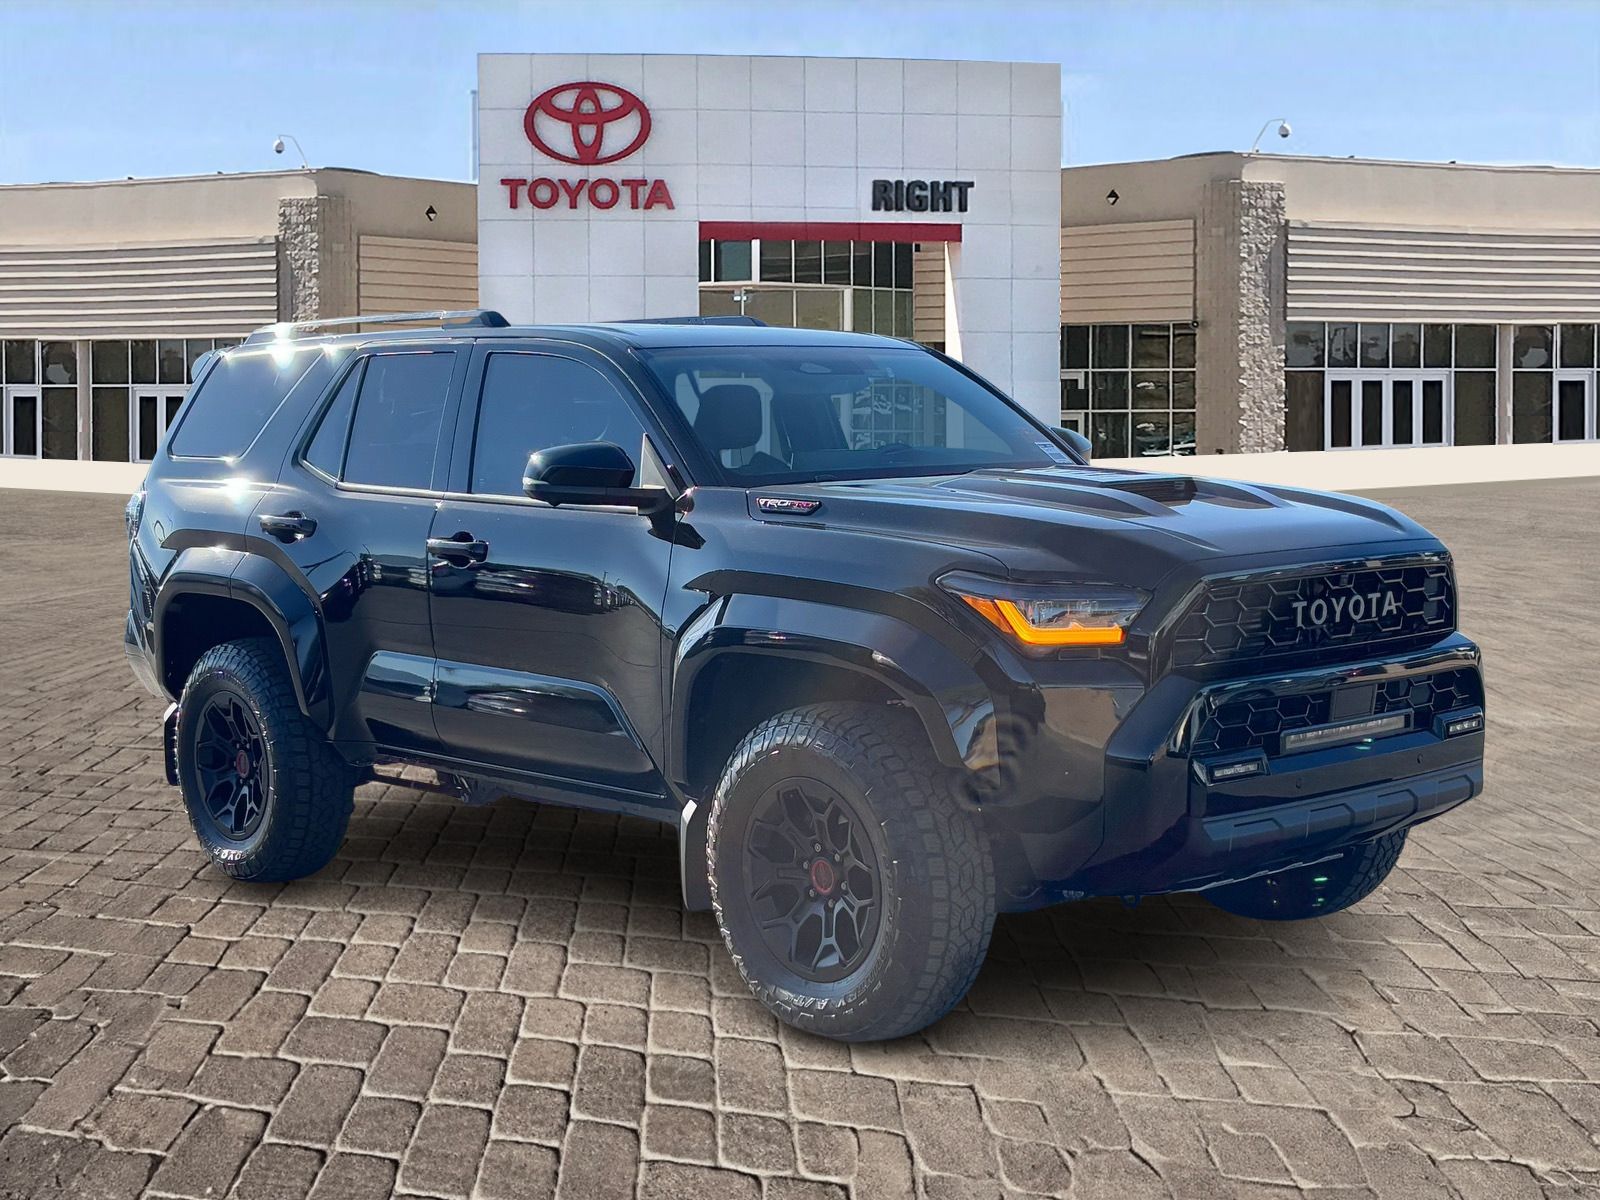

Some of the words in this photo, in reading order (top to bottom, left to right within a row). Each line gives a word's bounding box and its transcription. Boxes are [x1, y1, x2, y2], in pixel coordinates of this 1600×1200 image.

[500, 177, 675, 209] TOYOTA
[871, 179, 975, 212] RIGHT
[1292, 591, 1397, 628] TOYOTA
